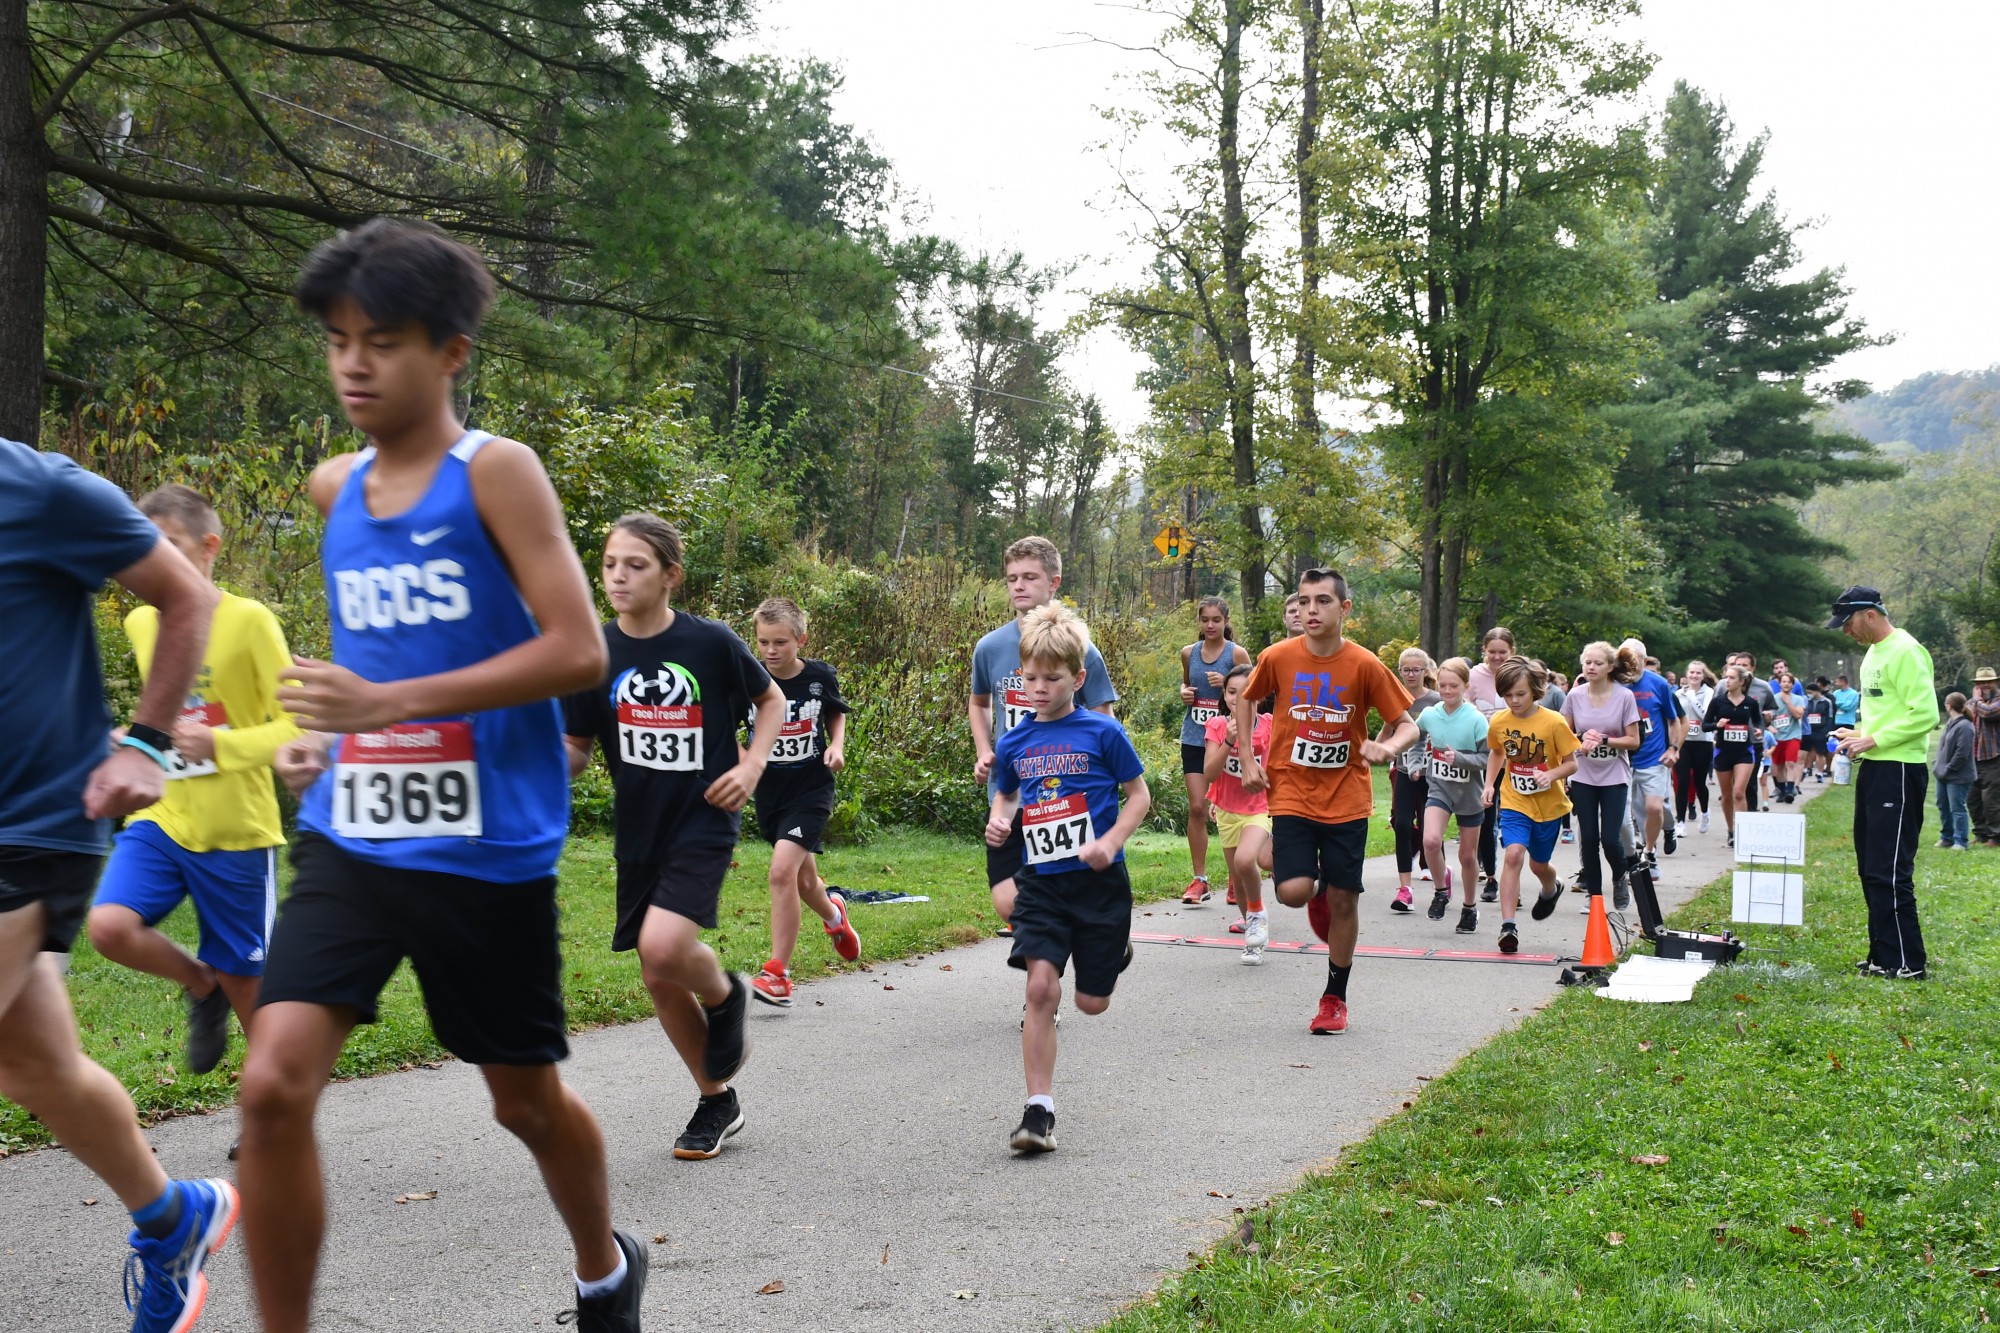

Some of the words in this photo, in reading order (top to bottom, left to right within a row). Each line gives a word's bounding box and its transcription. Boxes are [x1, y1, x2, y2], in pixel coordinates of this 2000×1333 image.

[333, 558, 472, 631] BCCS
[1002, 676, 1023, 690] BAS
[631, 708, 654, 719] race
[658, 708, 689, 720] result
[1292, 709, 1307, 721] RUN
[1325, 713, 1348, 723] WALK
[1308, 729, 1323, 739] race
[1326, 731, 1344, 739] result
[1725, 731, 1747, 740] 1315
[623, 729, 696, 763] 1331
[772, 735, 812, 758] 337
[1025, 743, 1072, 757] KANSAS
[1296, 742, 1349, 763] 1328
[1586, 746, 1618, 758] 354
[1433, 761, 1469, 779] 1350
[1511, 774, 1539, 792] 133
[338, 770, 469, 824] 1369
[1043, 799, 1071, 815] result
[1025, 816, 1089, 857] 1347
